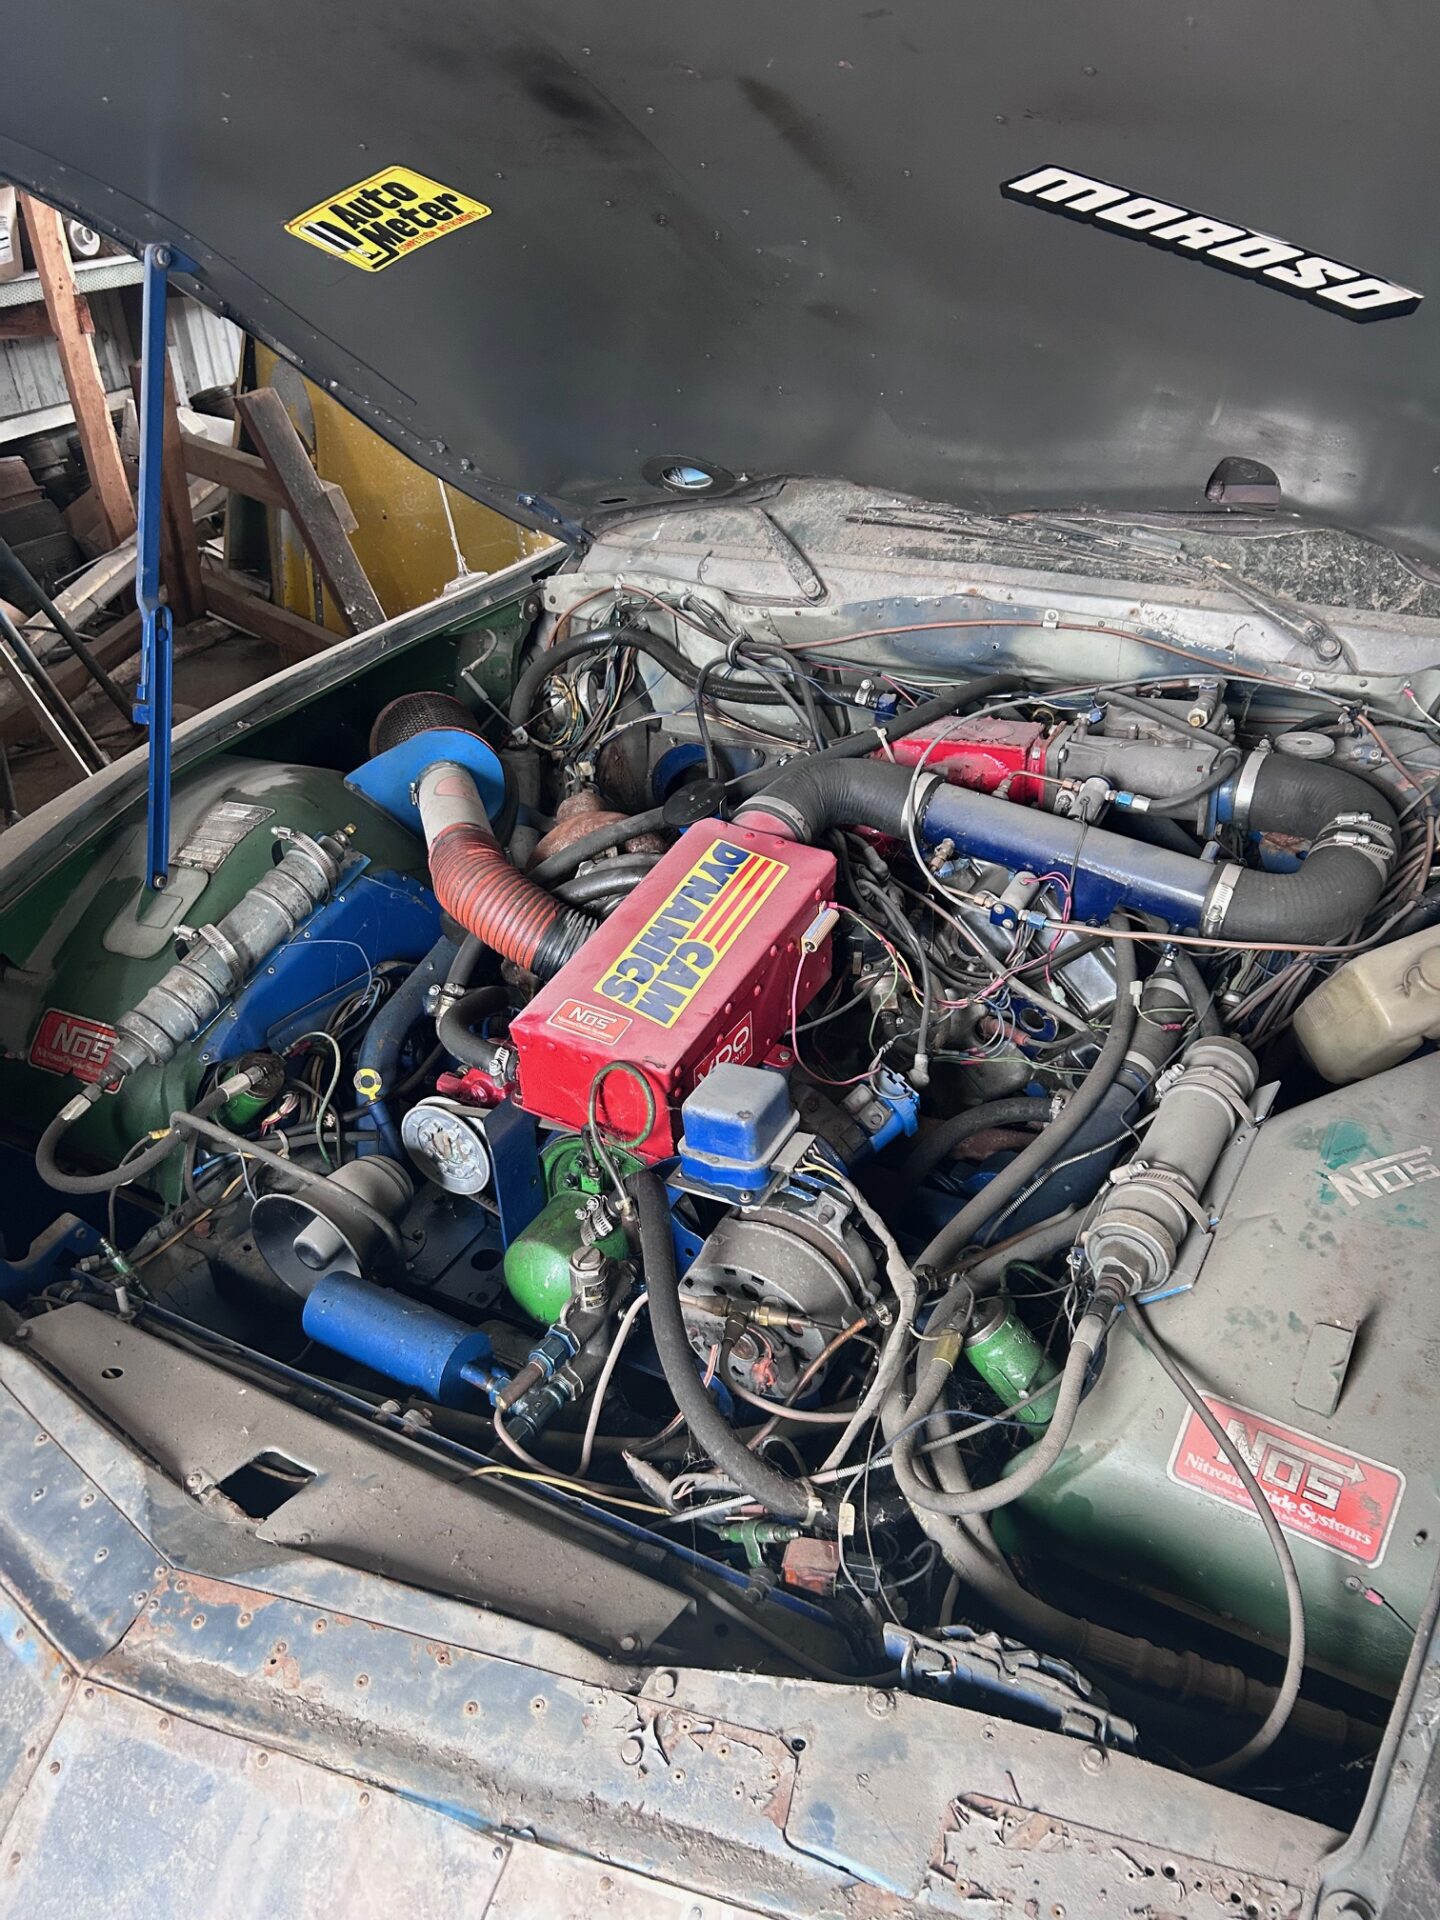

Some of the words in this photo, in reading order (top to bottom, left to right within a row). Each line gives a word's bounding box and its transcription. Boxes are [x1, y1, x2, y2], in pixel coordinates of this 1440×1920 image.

[328, 181, 419, 230] Auto
[357, 193, 465, 260] Meter
[602, 842, 751, 1004] DYNAMICS
[634, 941, 715, 1024] CAM
[51, 1022, 114, 1065] NOS
[568, 1006, 614, 1030] NOS
[1328, 1149, 1440, 1207] NOS
[1215, 1418, 1350, 1511] NOS
[1298, 1503, 1373, 1545] Systems
